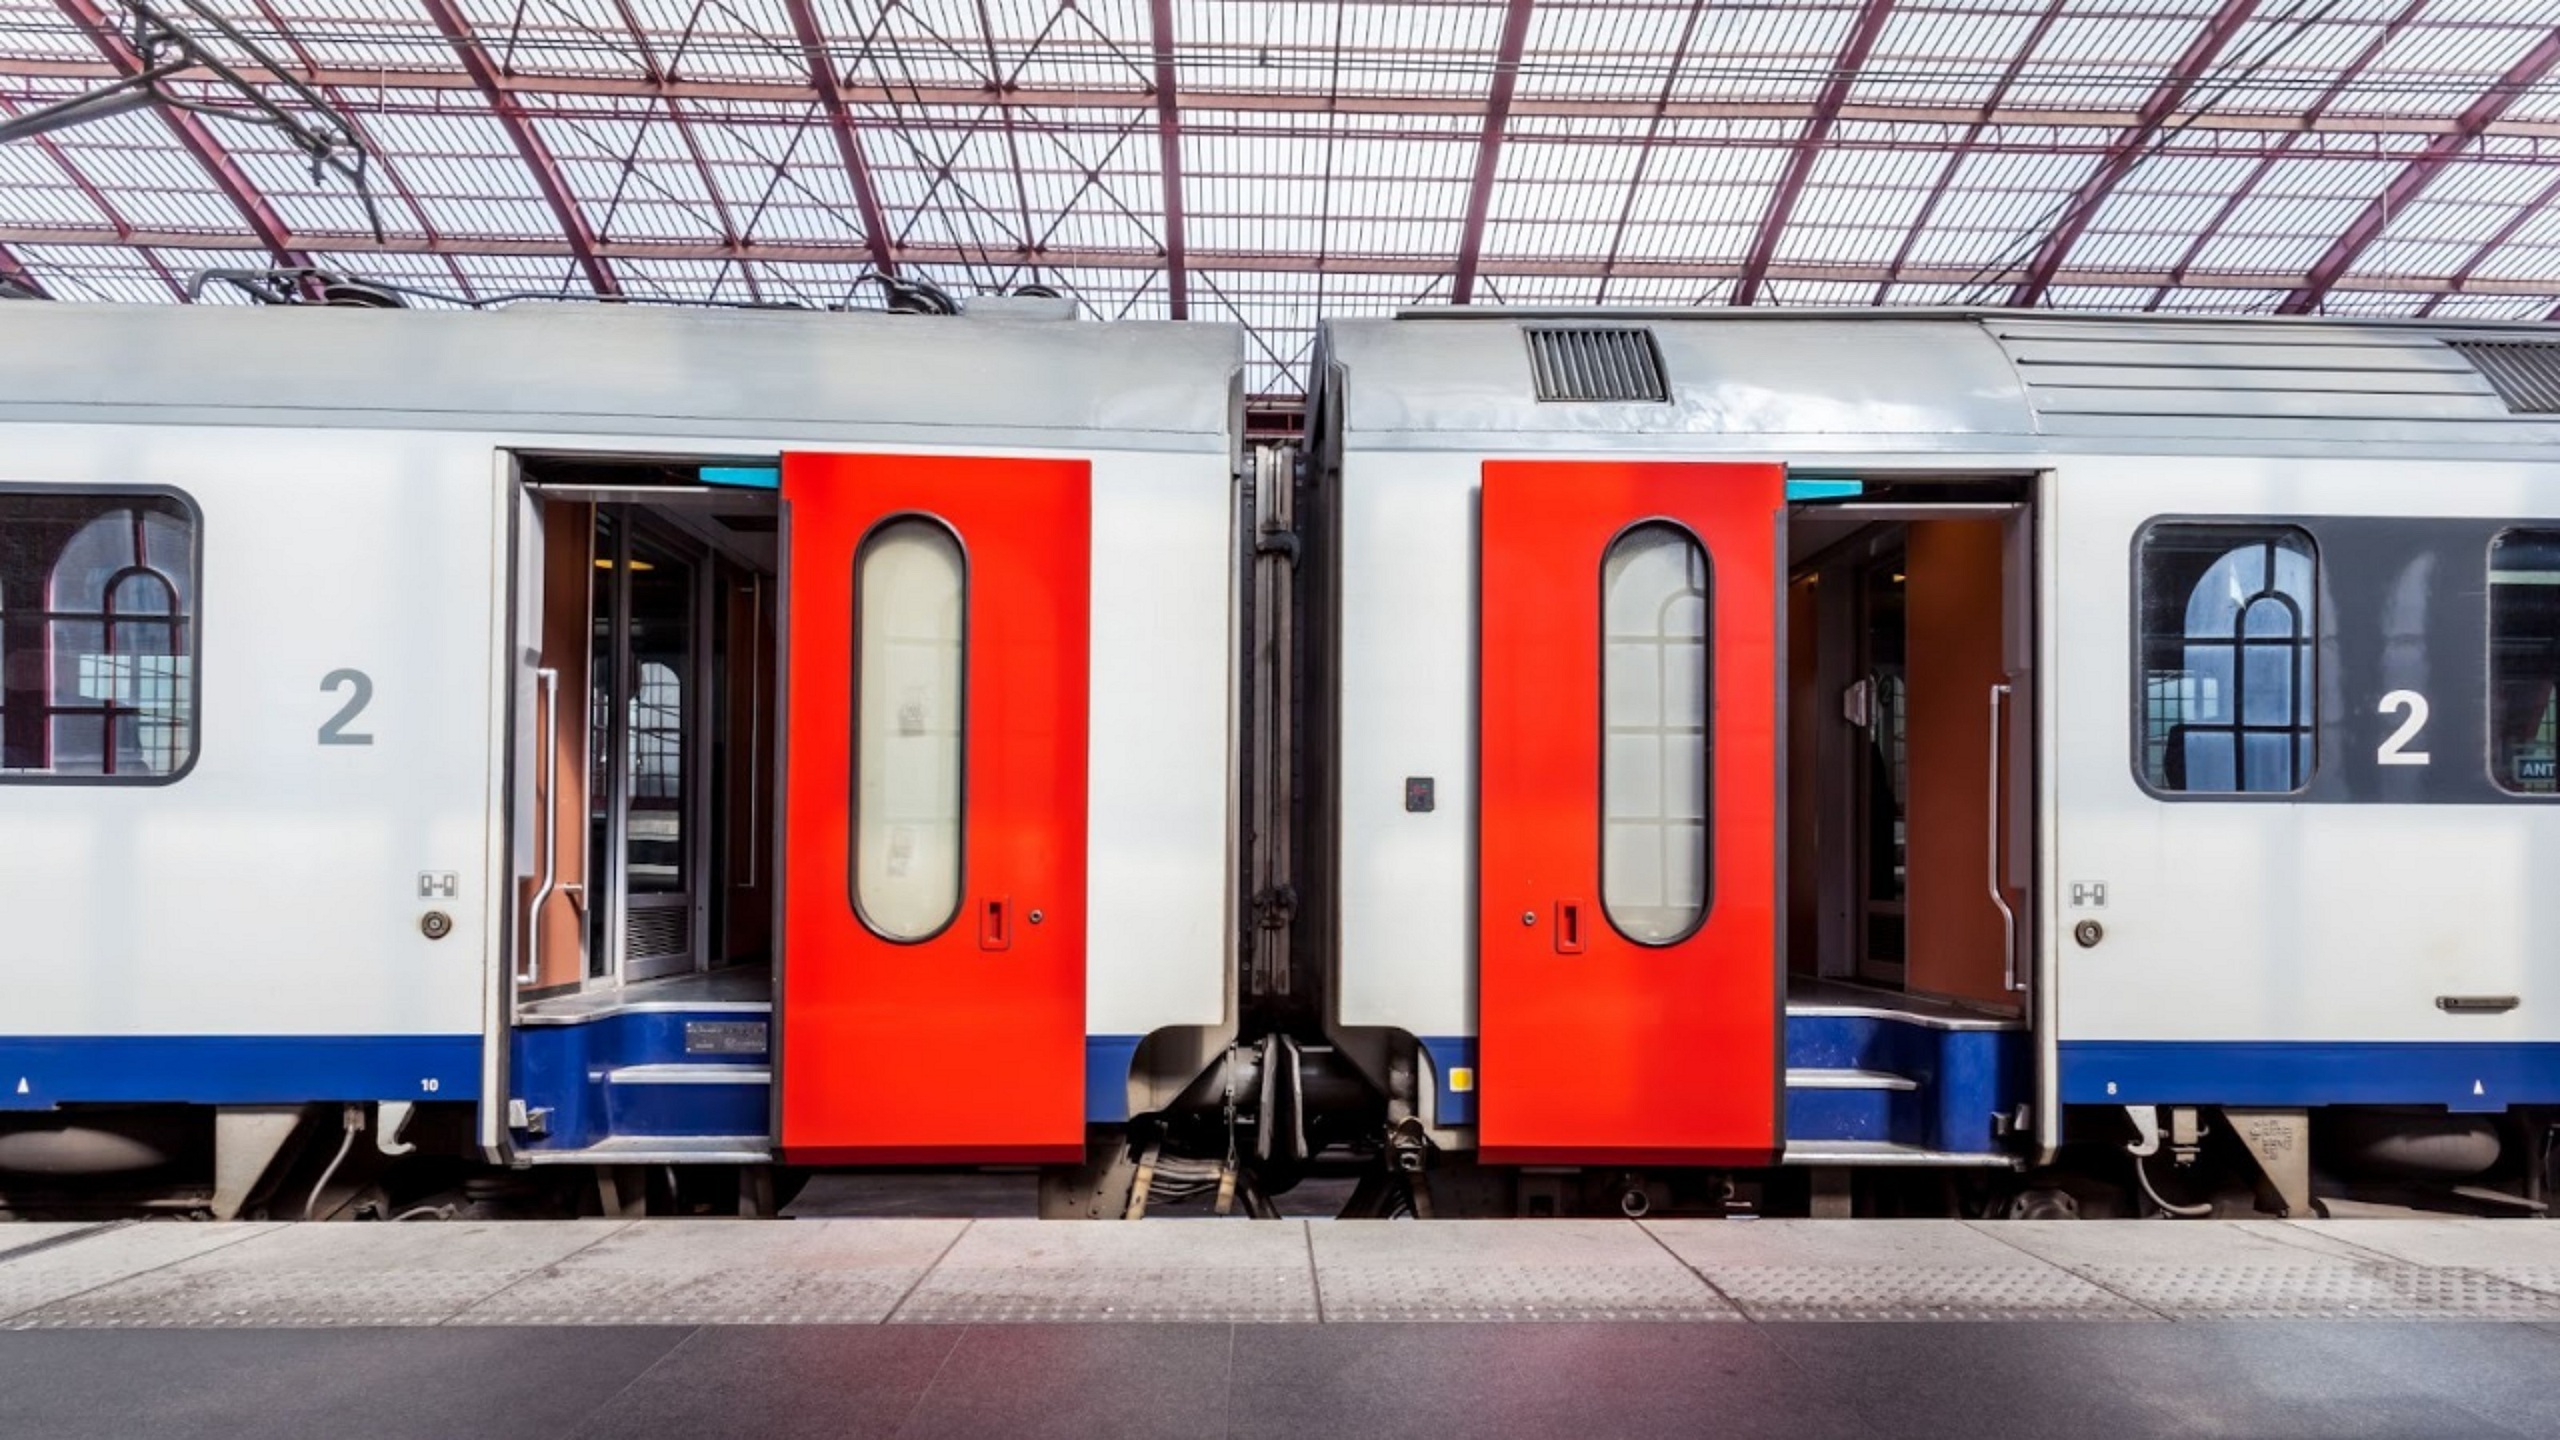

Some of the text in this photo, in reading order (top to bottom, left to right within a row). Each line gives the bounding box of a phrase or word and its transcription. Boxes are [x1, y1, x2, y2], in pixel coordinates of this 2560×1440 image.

[318, 669, 374, 746] 2
[2377, 689, 2430, 765] 2
[421, 1078, 439, 1092] 10
[2107, 1081, 2117, 1095] 8
